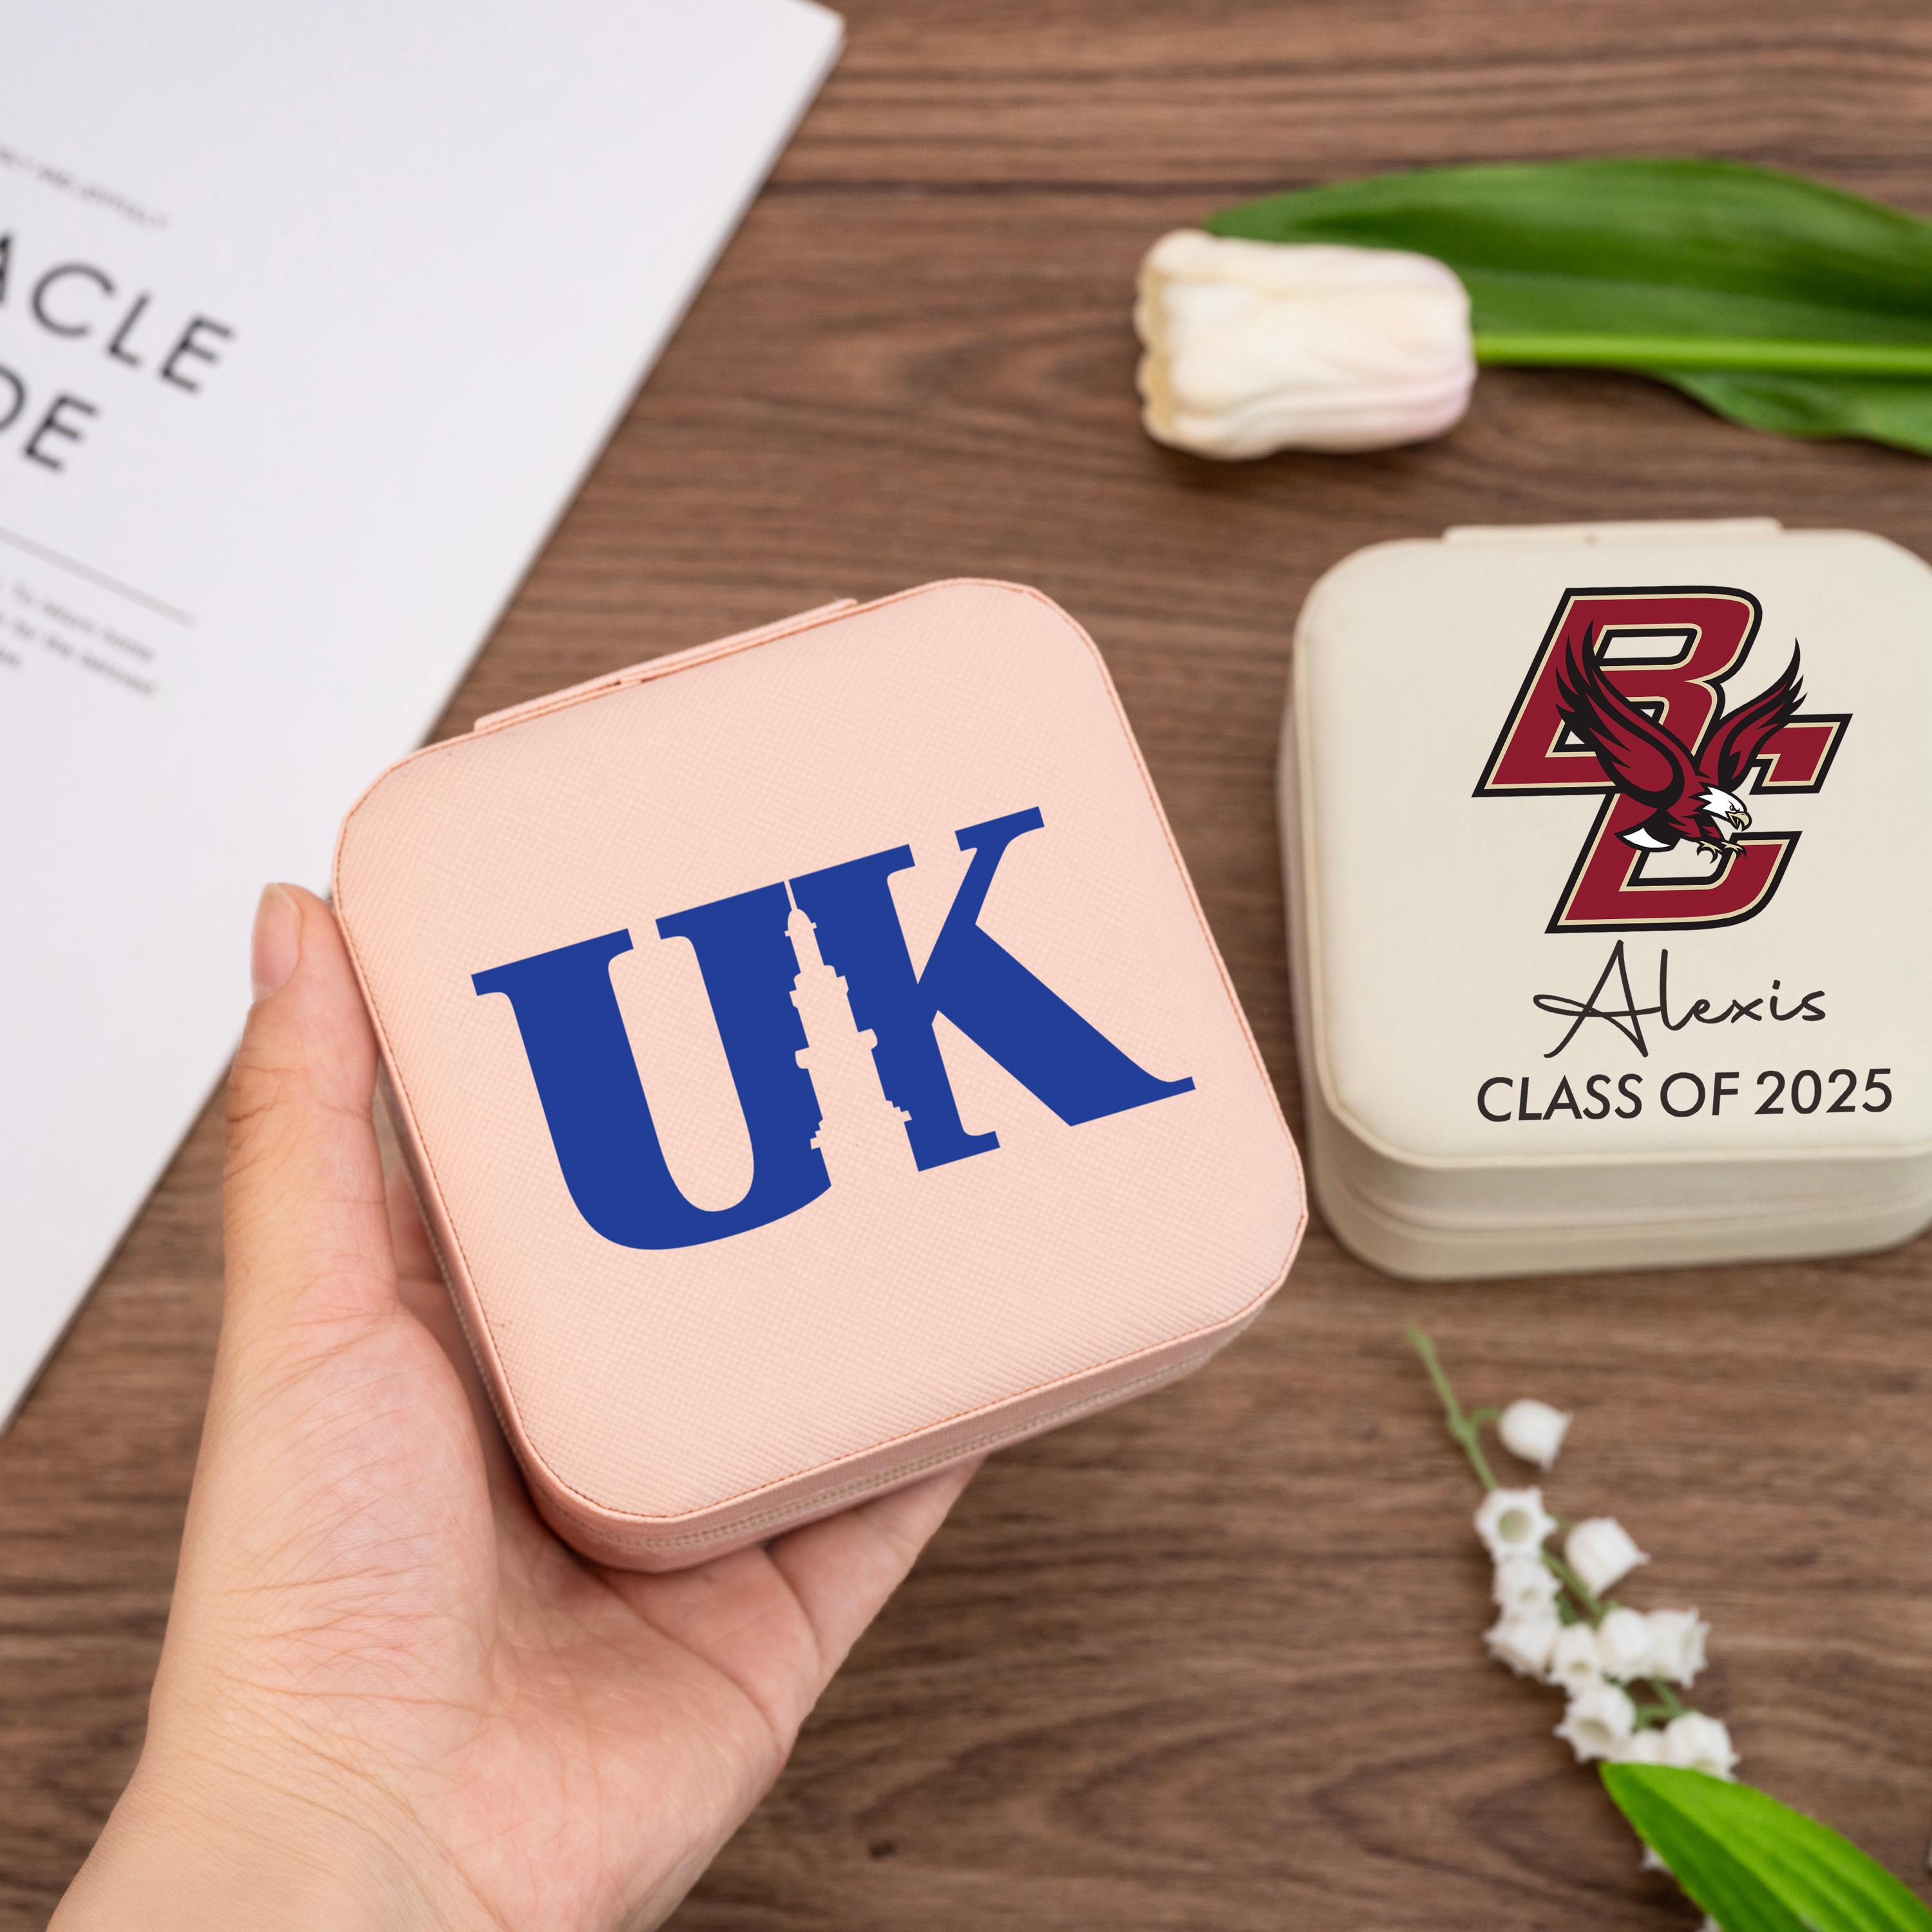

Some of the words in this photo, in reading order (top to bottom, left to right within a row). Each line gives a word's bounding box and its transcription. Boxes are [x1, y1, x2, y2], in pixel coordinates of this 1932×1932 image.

[1471, 585, 1853, 934] BC
[471, 807, 1195, 1249] UK
[1477, 1074, 1643, 1122] CLASS
[1660, 1072, 1739, 1117] OF
[1754, 1068, 1892, 1115] 2025
[1533, 939, 1826, 1059] Alexis
